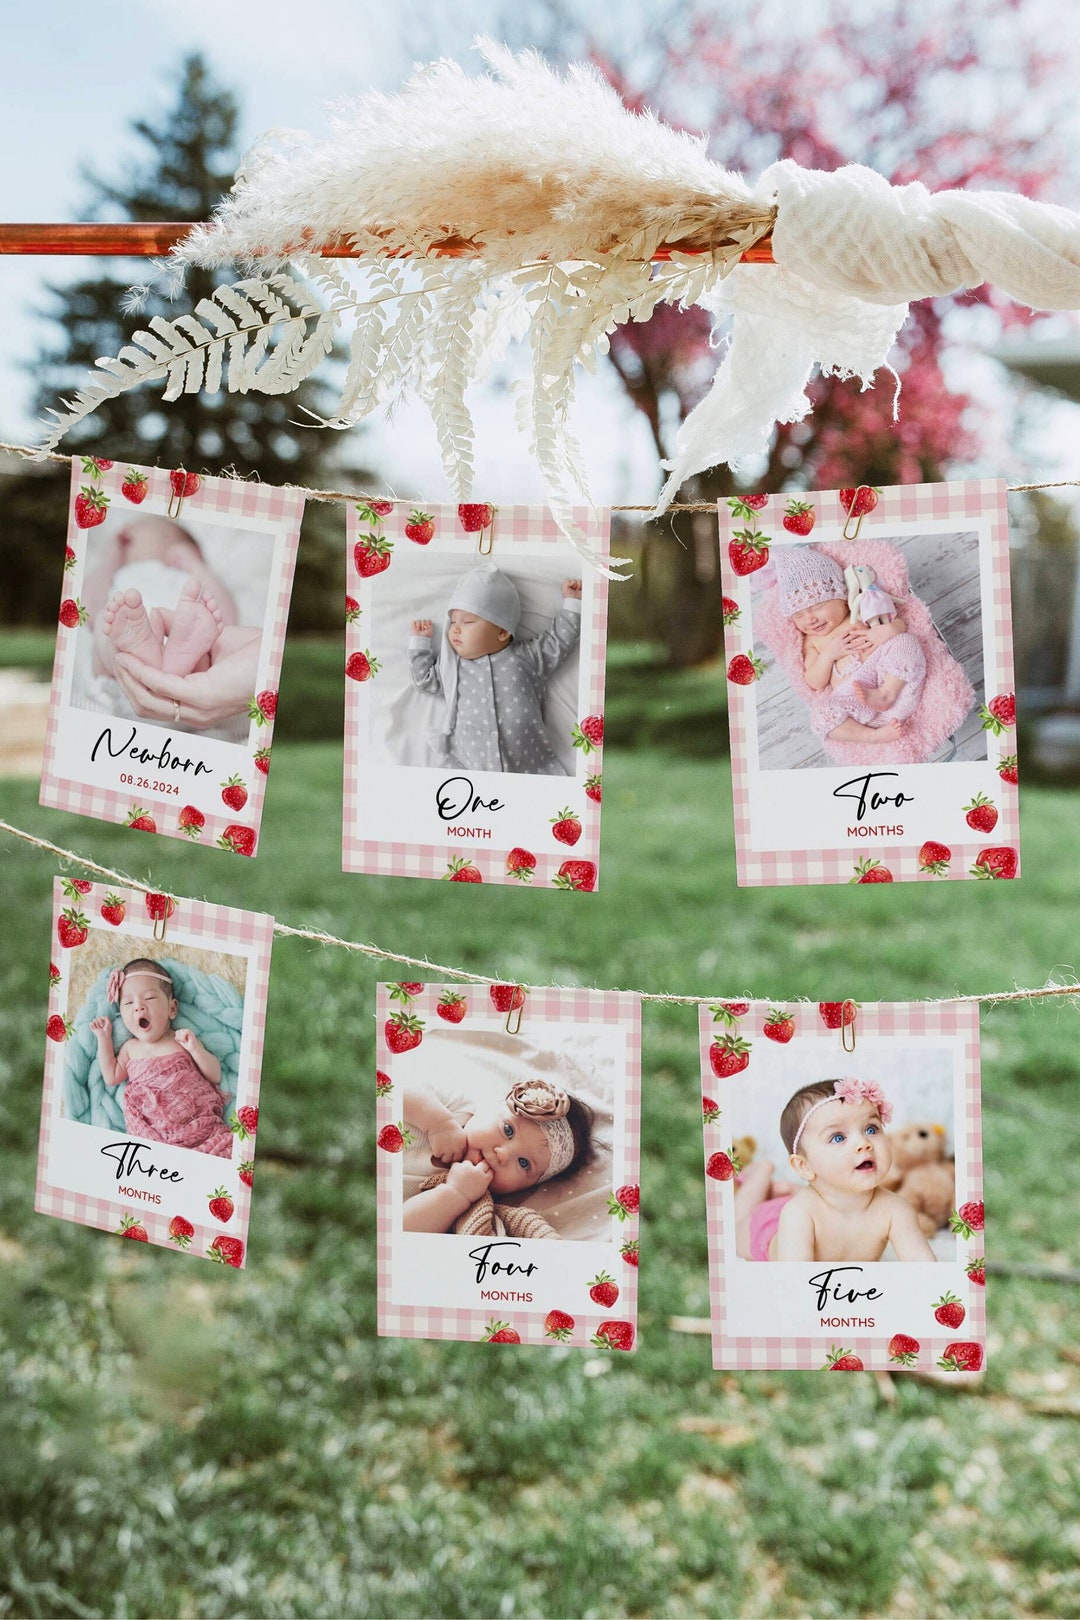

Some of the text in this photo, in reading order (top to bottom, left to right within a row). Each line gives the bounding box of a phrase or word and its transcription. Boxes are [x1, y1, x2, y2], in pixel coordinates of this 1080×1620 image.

[91, 727, 214, 776] Newborn
[120, 773, 180, 796] 08.26.2024
[436, 776, 506, 821] One
[832, 772, 915, 821] Two
[446, 826, 492, 839] MONTH
[847, 825, 905, 837] MONTHS
[100, 1141, 185, 1184] Three
[118, 1186, 162, 1206] MONTHS
[468, 1241, 539, 1284] Four
[481, 1290, 534, 1303] MONTHS
[808, 1266, 884, 1312] Five
[820, 1316, 876, 1328] MONTHS
